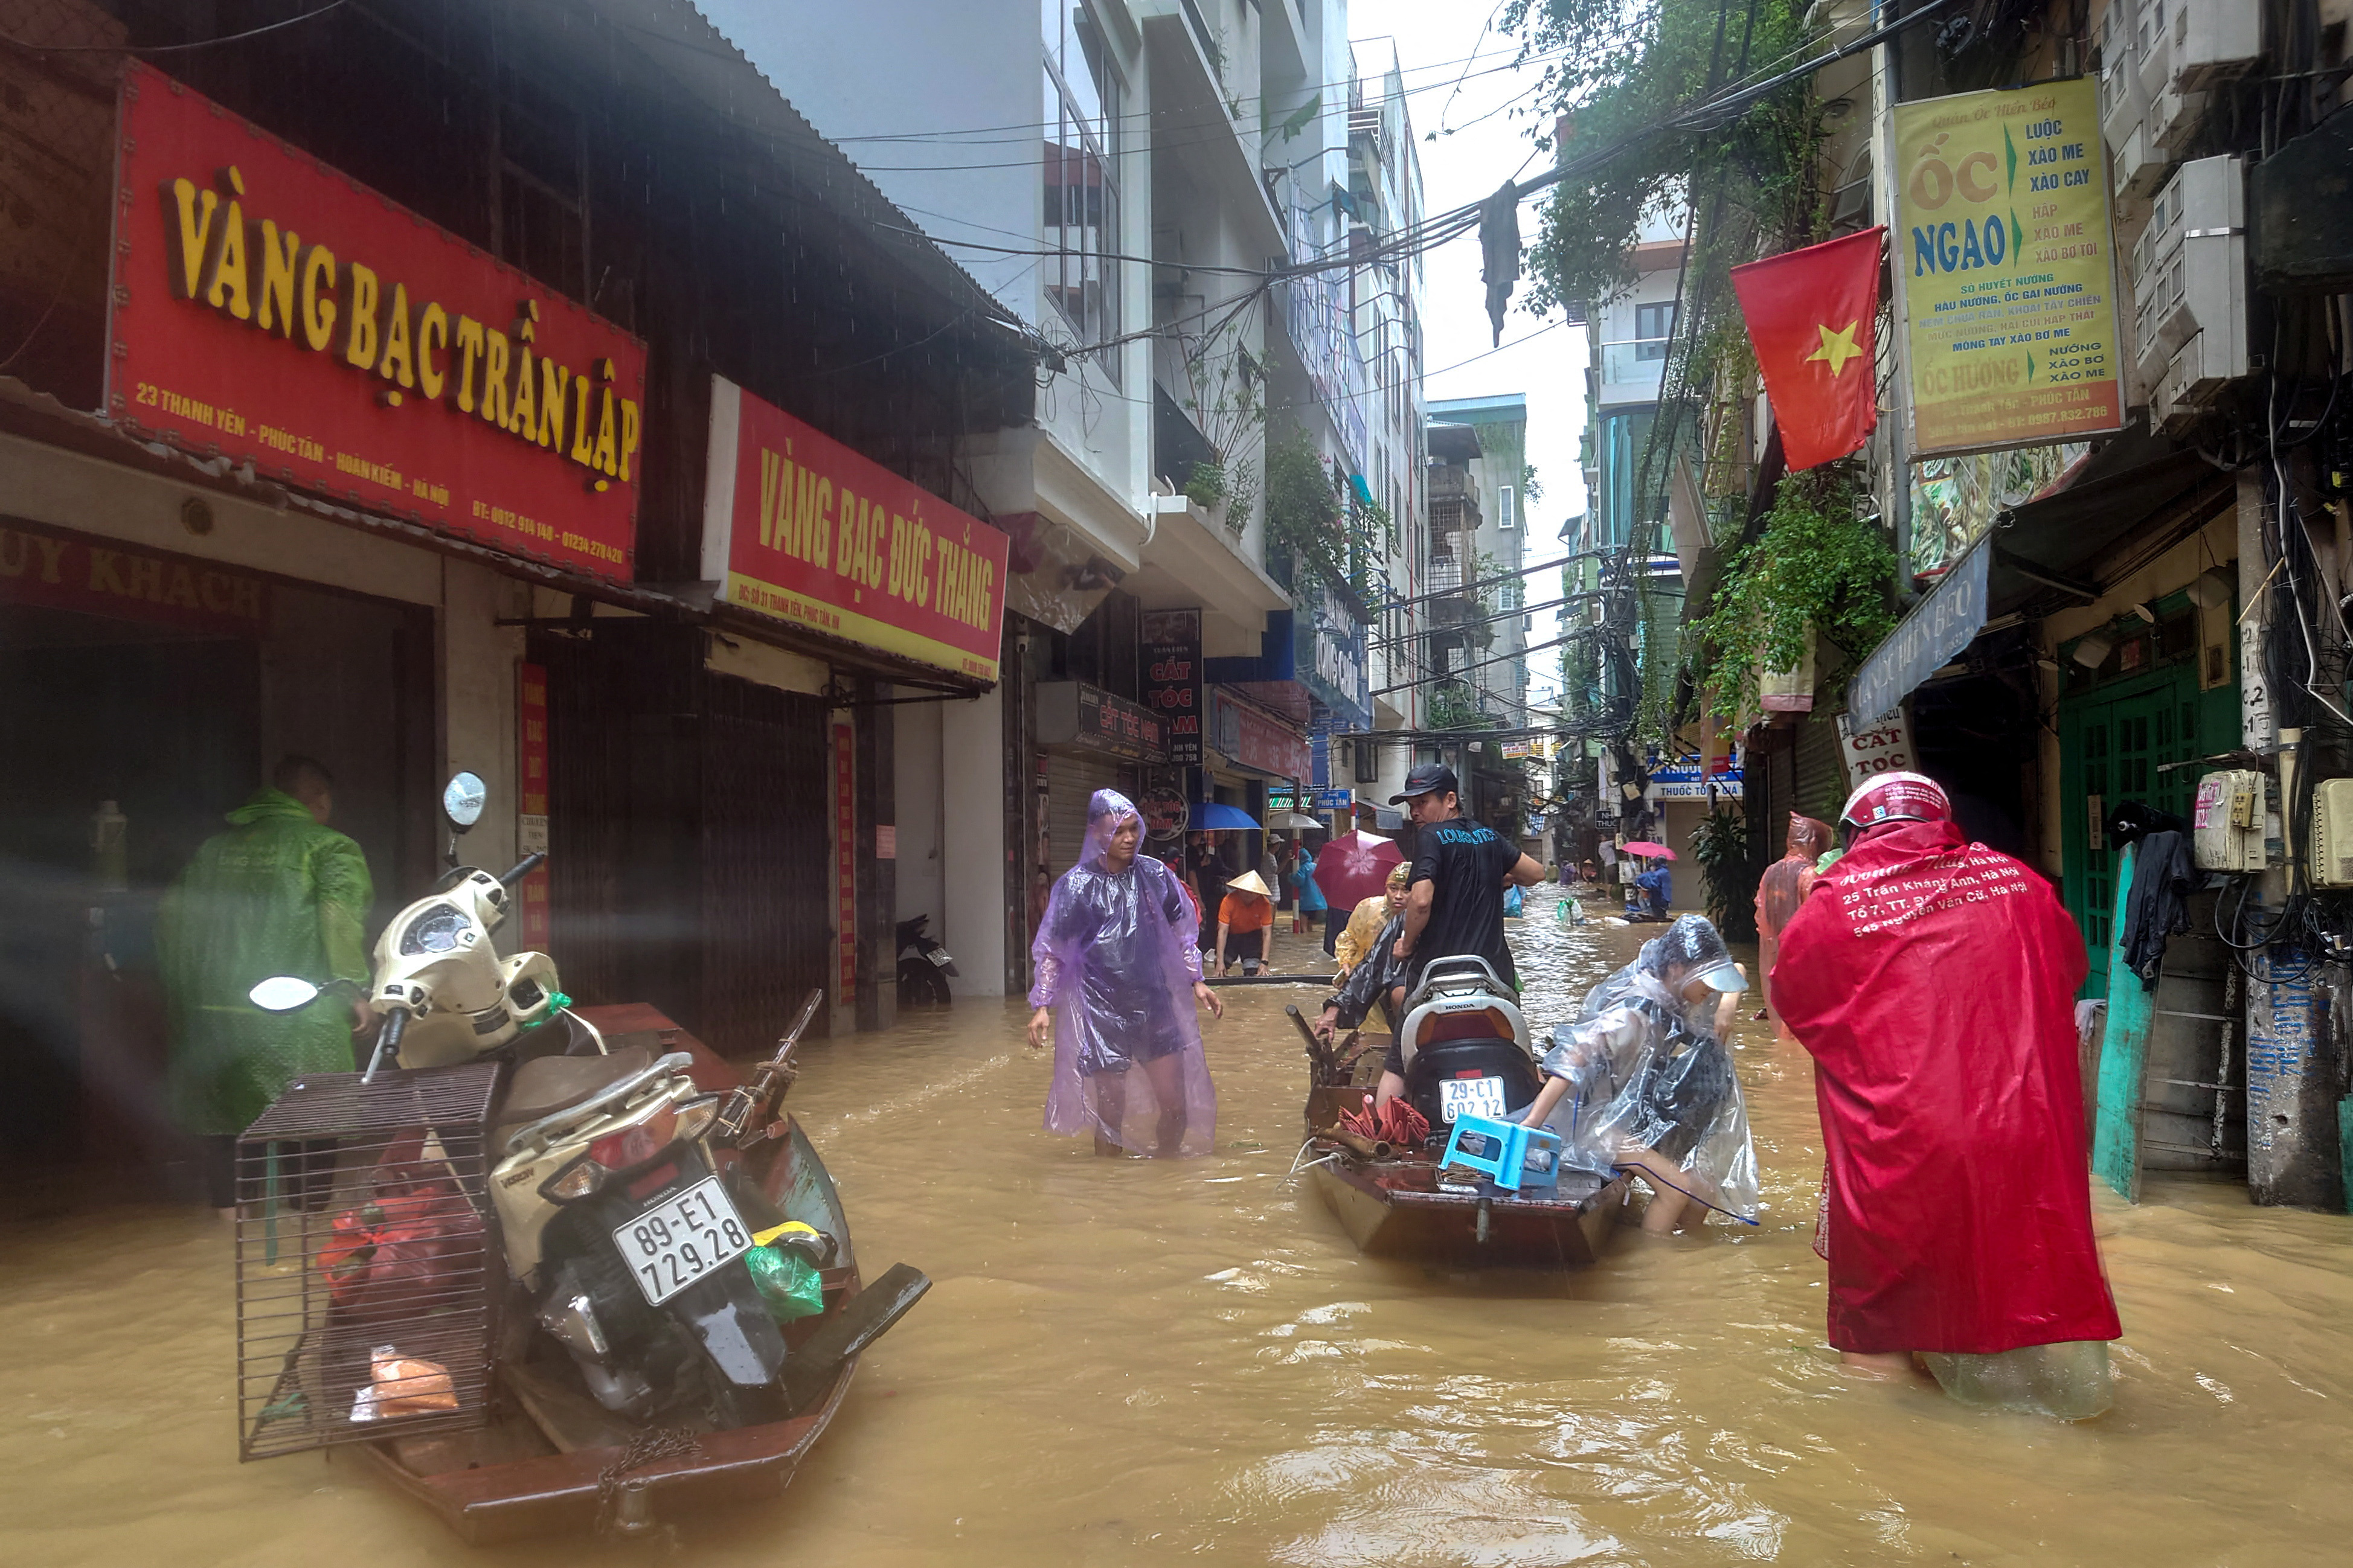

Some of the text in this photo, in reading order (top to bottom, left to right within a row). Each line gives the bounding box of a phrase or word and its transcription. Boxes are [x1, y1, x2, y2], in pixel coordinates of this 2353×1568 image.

[2025, 119, 2062, 140] LUỘC
[2028, 143, 2084, 167] XÀO ME
[1908, 132, 1998, 211] ỐC
[2030, 168, 2090, 193] XÀO CAY
[2034, 222, 2084, 242] XÀO ME
[1912, 214, 2006, 277] NGAO
[2035, 246, 2058, 263] XÀO
[2061, 244, 2077, 260] BƠ
[1960, 272, 2054, 295] SÒ HUYẾT NƯỚNG
[1934, 300, 1956, 313] HÀU
[1959, 295, 2001, 309] NƯỚNG,
[2023, 287, 2041, 299] GAI
[2044, 283, 2083, 296] NƯỚNG
[1919, 318, 1944, 329] NEM
[1947, 312, 1976, 325] CHUA
[2007, 302, 2041, 316] KHOAI
[173, 164, 639, 493] VÀNG BẠC TRẦN LẬP
[1952, 327, 2071, 352] MÓNG TAY XÀO BƠ ME
[2049, 342, 2102, 356] NƯỚNG
[2048, 353, 2105, 370] XÀO BƠ
[2050, 368, 2105, 383] XÀO ME
[2030, 391, 2063, 407] PHÚC
[2066, 388, 2090, 402] TÂN
[136, 382, 158, 407] 23
[161, 389, 214, 426] THANH
[216, 408, 246, 437] YÊN
[258, 424, 296, 454] PHÚC
[297, 435, 324, 463] TÂN
[336, 451, 371, 481] HOÀN
[371, 462, 403, 491] KIẾM
[413, 478, 429, 501] HÀ
[429, 484, 450, 510] NỘI
[518, 515, 536, 535] 914
[562, 531, 589, 554] 01234
[759, 437, 994, 633] VÀNG BẠC ĐỨC THẮNG
[751, 583, 760, 605] SỐ
[760, 590, 768, 607] 31
[769, 594, 789, 614] THANH
[1150, 656, 1192, 681] CẮT
[1148, 685, 1192, 708] TÓC
[1100, 696, 1119, 731] CẮT
[1120, 708, 1140, 738] TÓC
[1317, 797, 1334, 807] PHÚC
[1335, 798, 1347, 806] TÂN
[1661, 784, 1692, 796] THUỐC
[1149, 818, 1173, 830] NAM
[1970, 856, 1987, 866] Hà
[1989, 853, 2009, 864] Nội
[1843, 892, 1860, 904] 25
[1863, 884, 1899, 898] Trần
[1847, 866, 2020, 920] Tổ 7, TT. Anh, Hà Nội
[1854, 922, 1879, 937] 545
[1937, 895, 1963, 910] Văn
[1966, 890, 1989, 903] Cừ,
[1991, 884, 2008, 897] Hà
[2010, 880, 2028, 892] Nội
[1449, 1080, 1493, 1100] 29-C1
[500, 1166, 534, 1189] VISION
[643, 1186, 677, 1207] HONDA
[633, 1189, 717, 1256] 89-E1
[640, 1217, 745, 1298] 729.28
